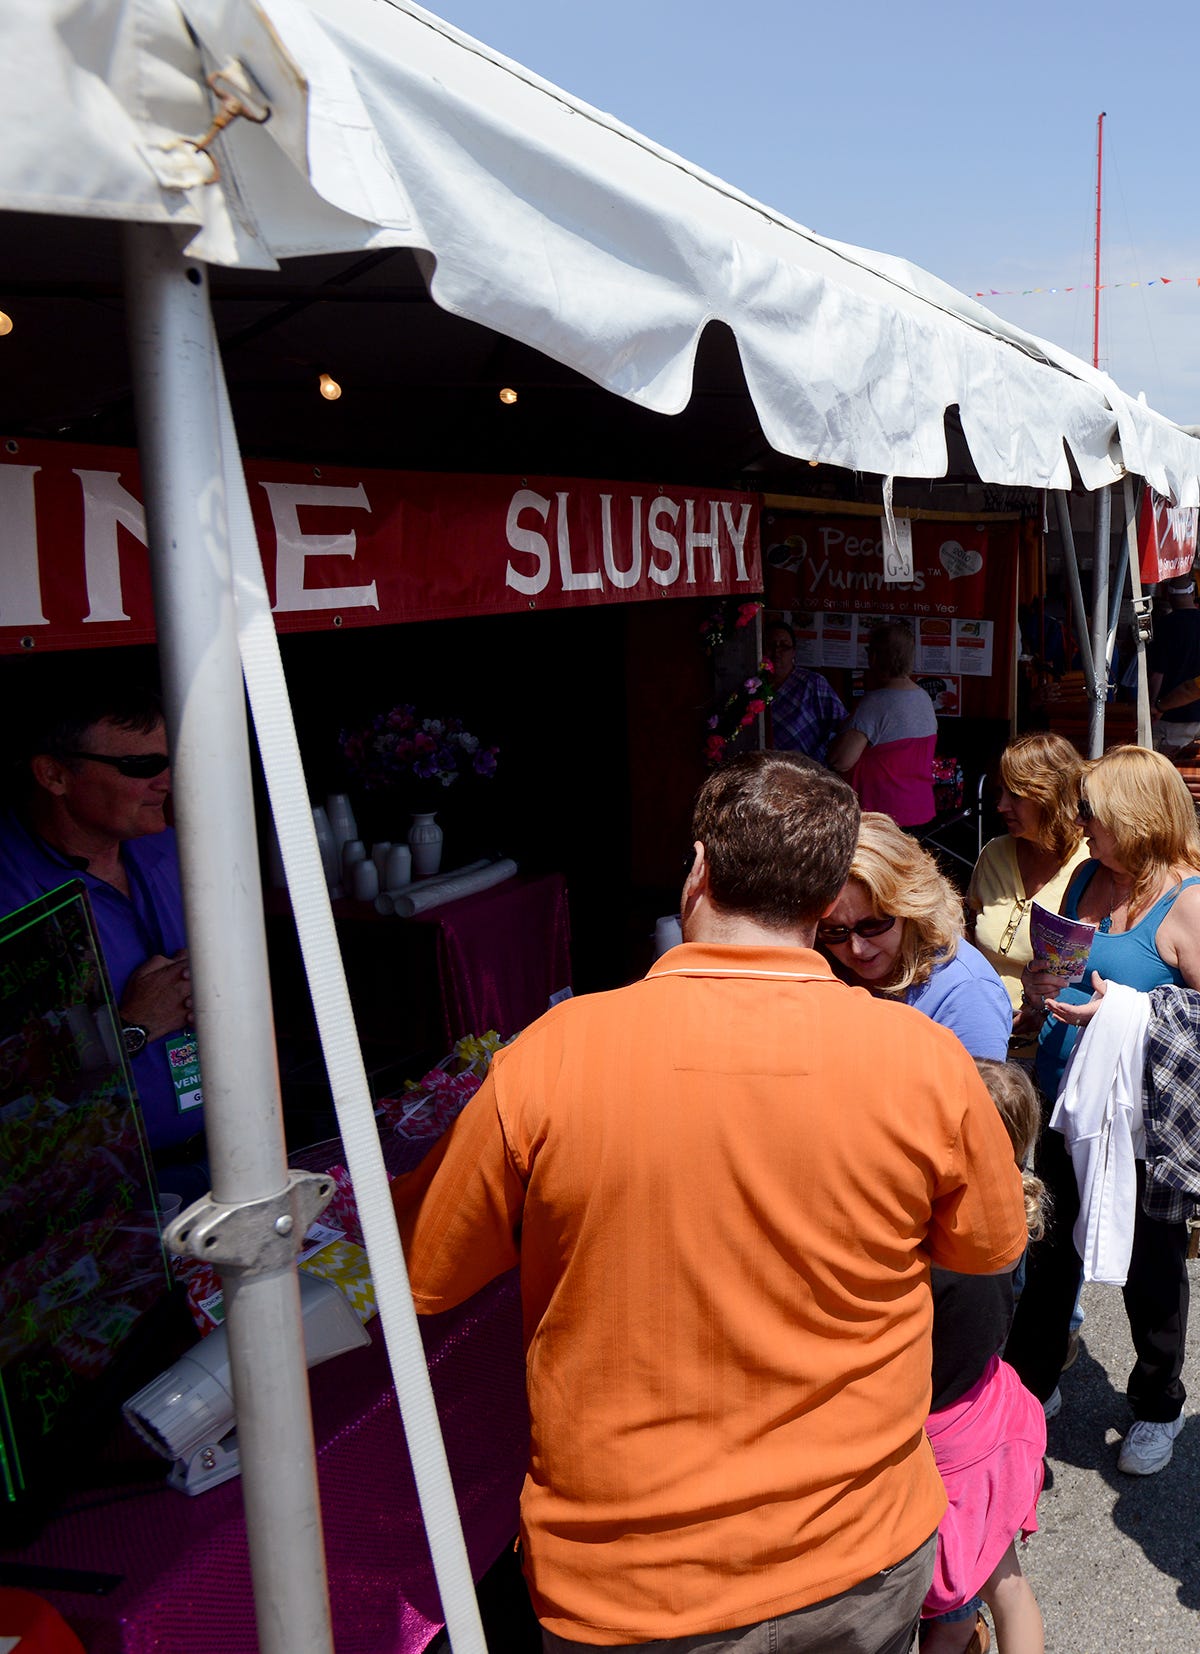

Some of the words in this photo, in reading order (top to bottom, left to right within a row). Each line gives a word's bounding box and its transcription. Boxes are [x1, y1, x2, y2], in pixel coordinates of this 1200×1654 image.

[505, 488, 753, 596] SLUSHY
[818, 527, 883, 557] Pec
[913, 602, 930, 613] the
[935, 603, 959, 614] Year
